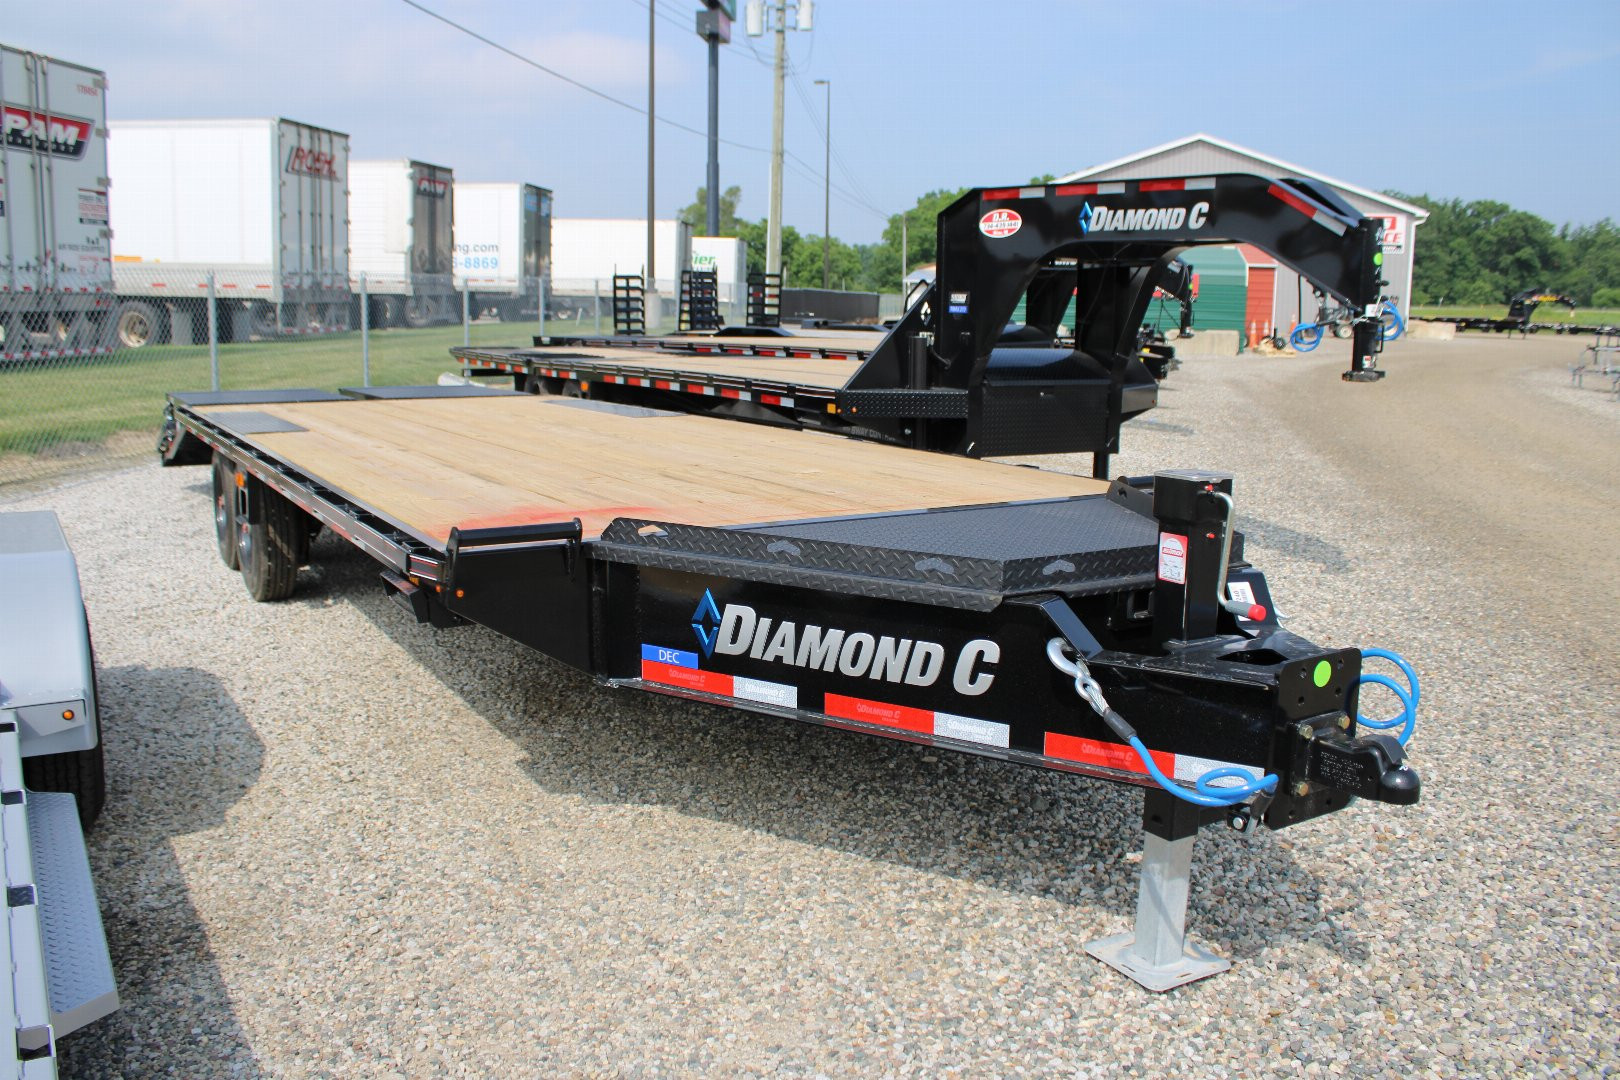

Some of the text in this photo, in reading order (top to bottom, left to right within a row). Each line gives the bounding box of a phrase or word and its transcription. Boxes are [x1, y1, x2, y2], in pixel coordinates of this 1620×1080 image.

[4, 113, 80, 146] PAM
[1088, 201, 1210, 232] DIAMOND C
[658, 649, 681, 664] DEC
[714, 603, 1001, 696] DIAMOND C
[861, 704, 901, 719] DIAMOND C
